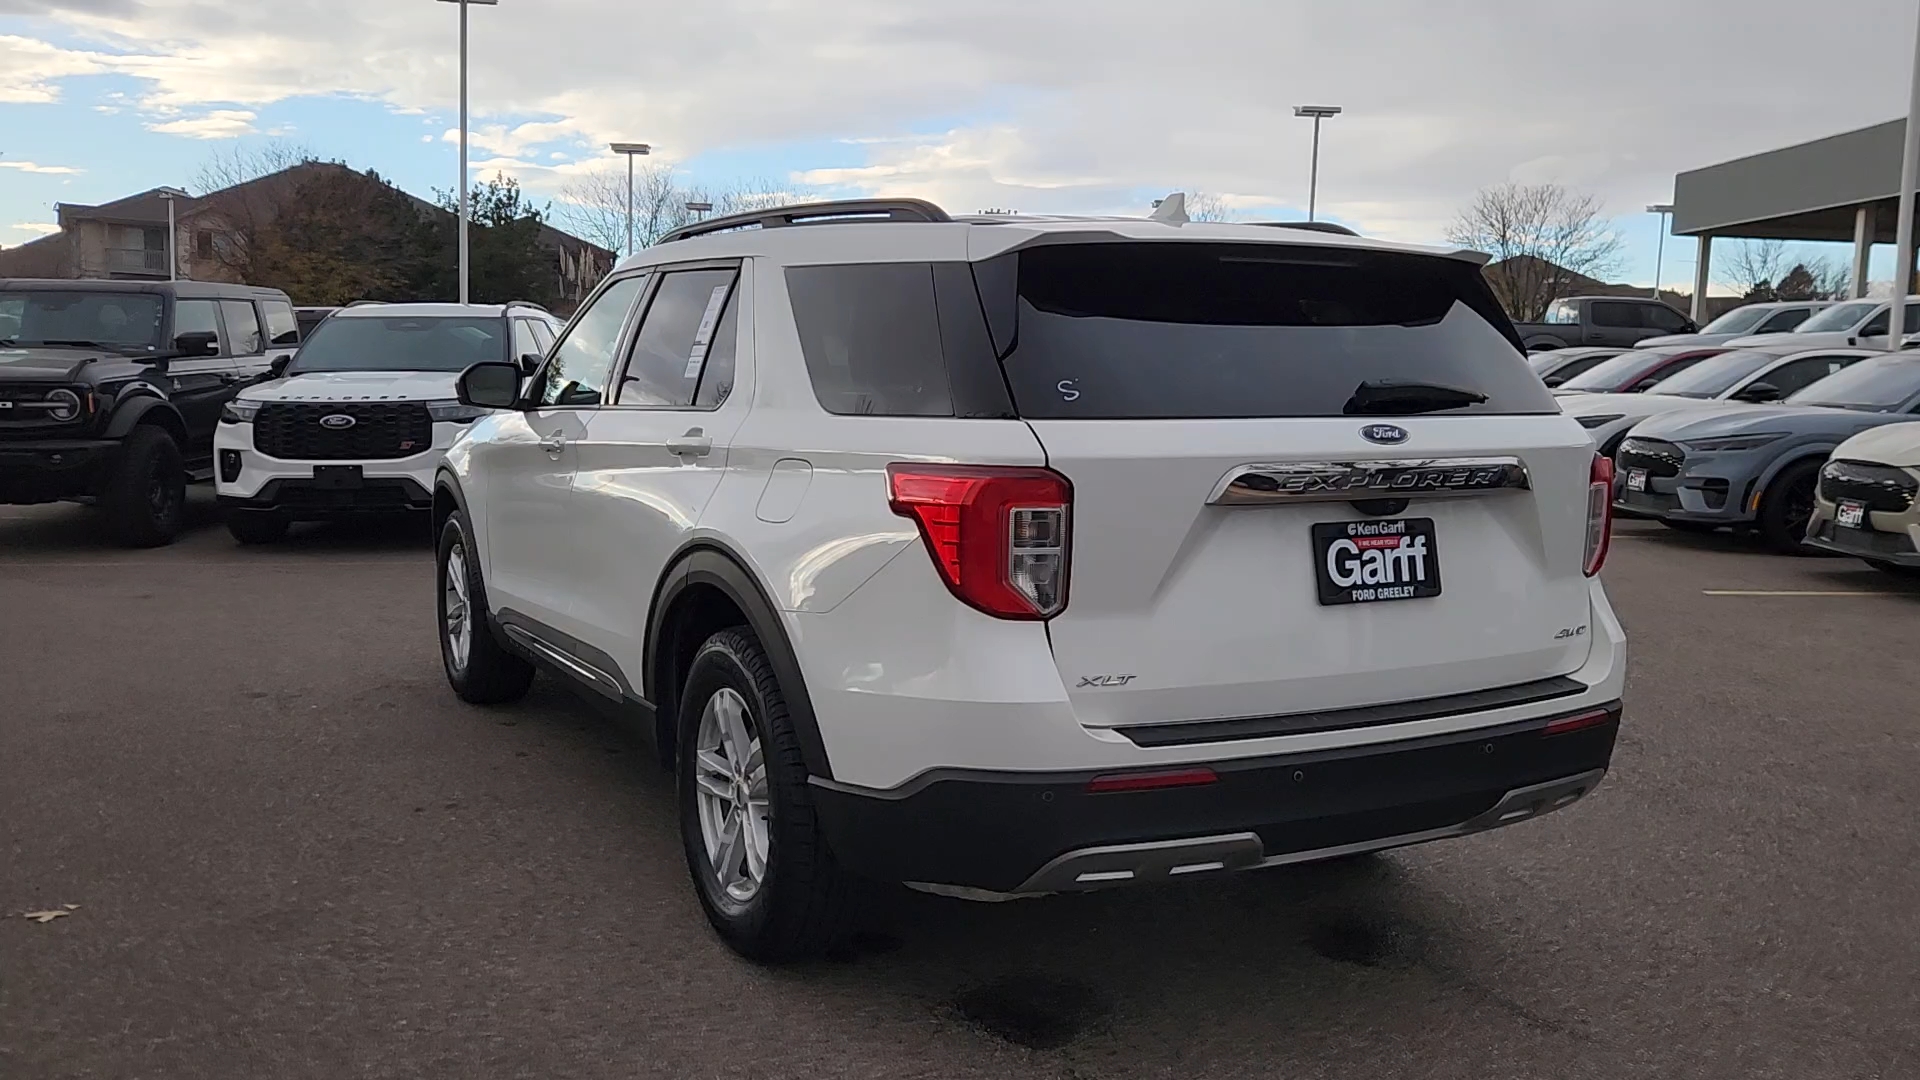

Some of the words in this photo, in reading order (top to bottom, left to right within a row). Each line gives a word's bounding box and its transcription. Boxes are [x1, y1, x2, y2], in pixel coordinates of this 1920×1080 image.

[1372, 426, 1401, 439] Ford
[1278, 468, 1496, 492] EXPLORER
[1357, 522, 1379, 535] Ken
[1379, 520, 1405, 534] Garff
[1327, 535, 1427, 587] Garff
[1352, 588, 1376, 601] FORD
[1377, 586, 1415, 599] GREELEY
[1076, 675, 1137, 687] XLT
